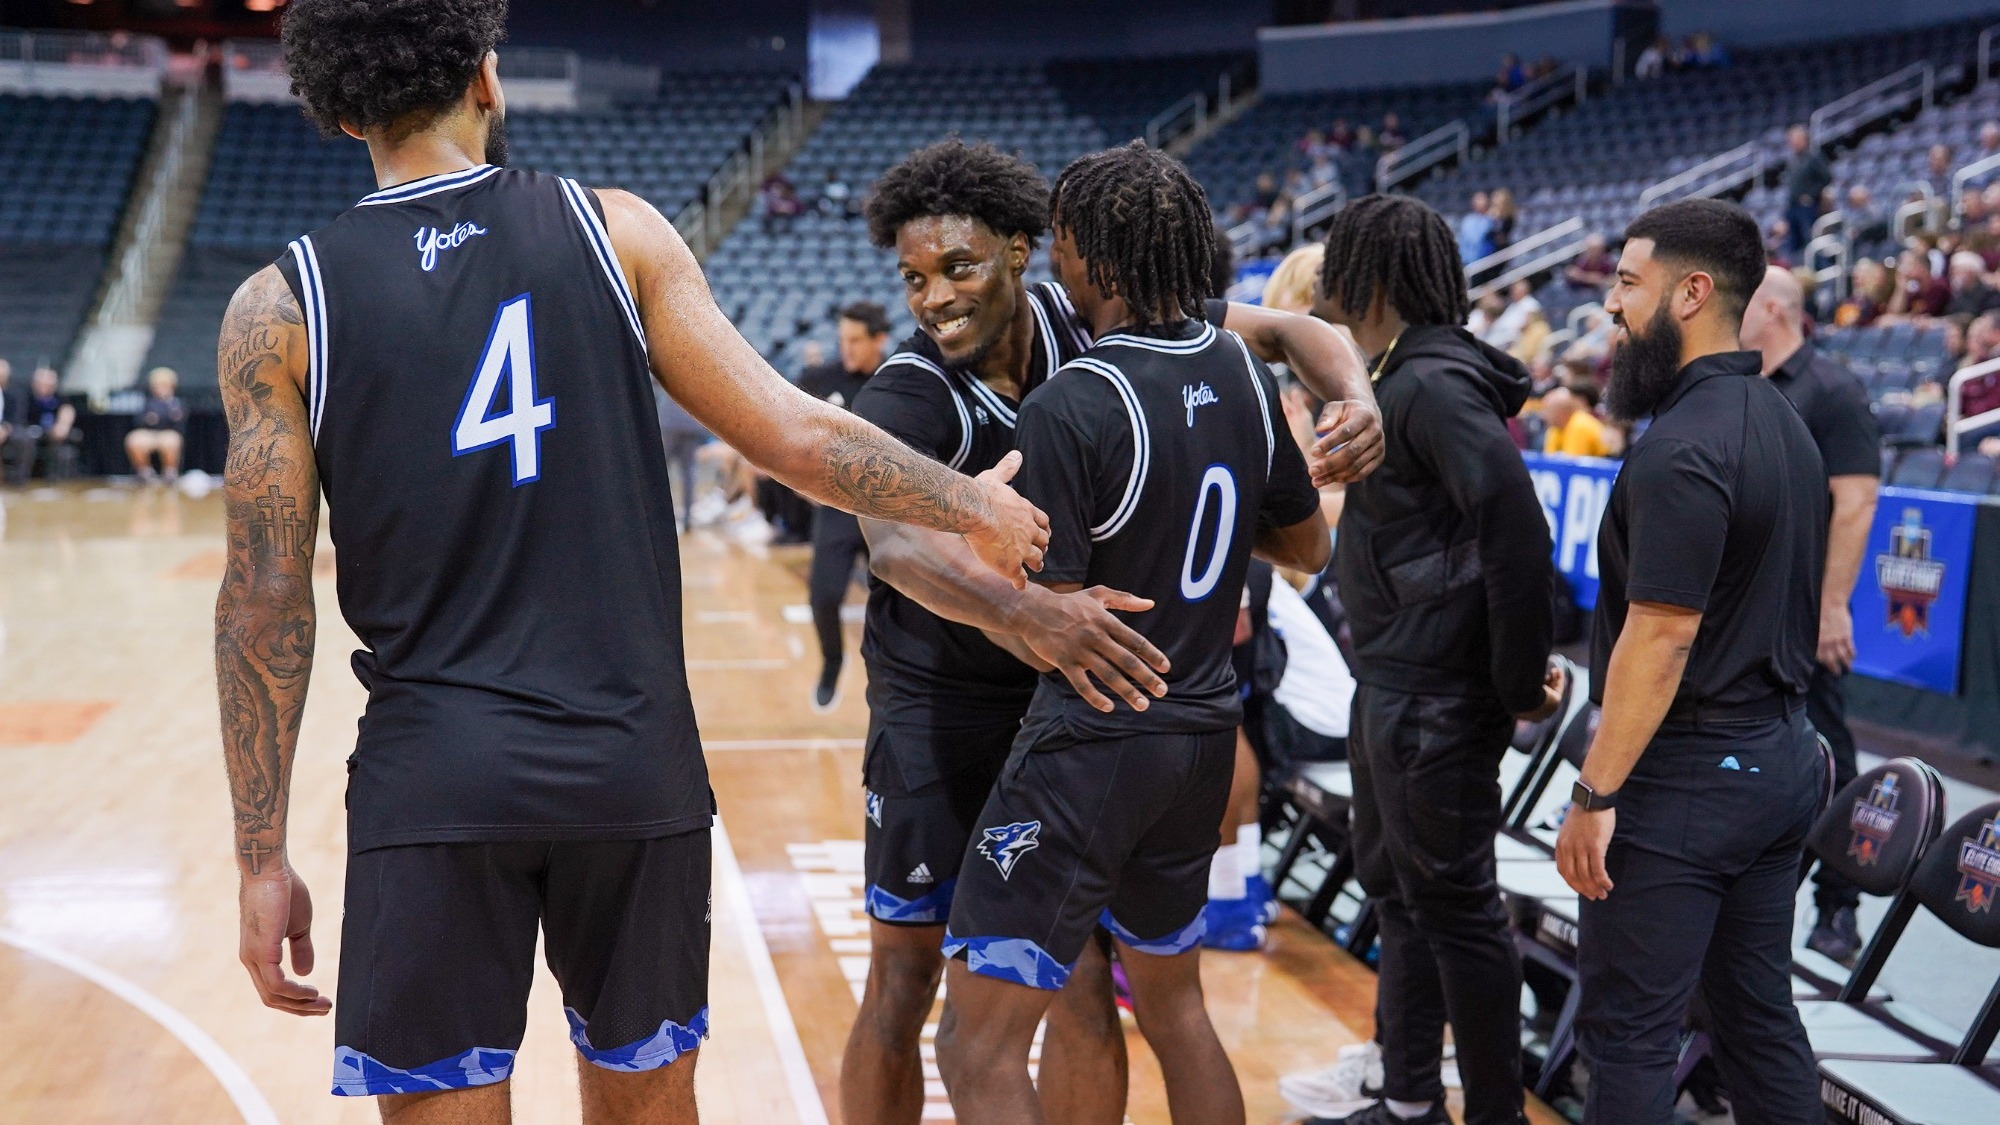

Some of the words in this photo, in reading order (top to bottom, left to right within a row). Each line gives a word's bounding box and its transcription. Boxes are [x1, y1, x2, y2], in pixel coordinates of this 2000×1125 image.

[413, 220, 488, 272] Yotes
[451, 292, 556, 487] 4
[1181, 380, 1219, 428] Yotes
[1180, 462, 1239, 603] 0
